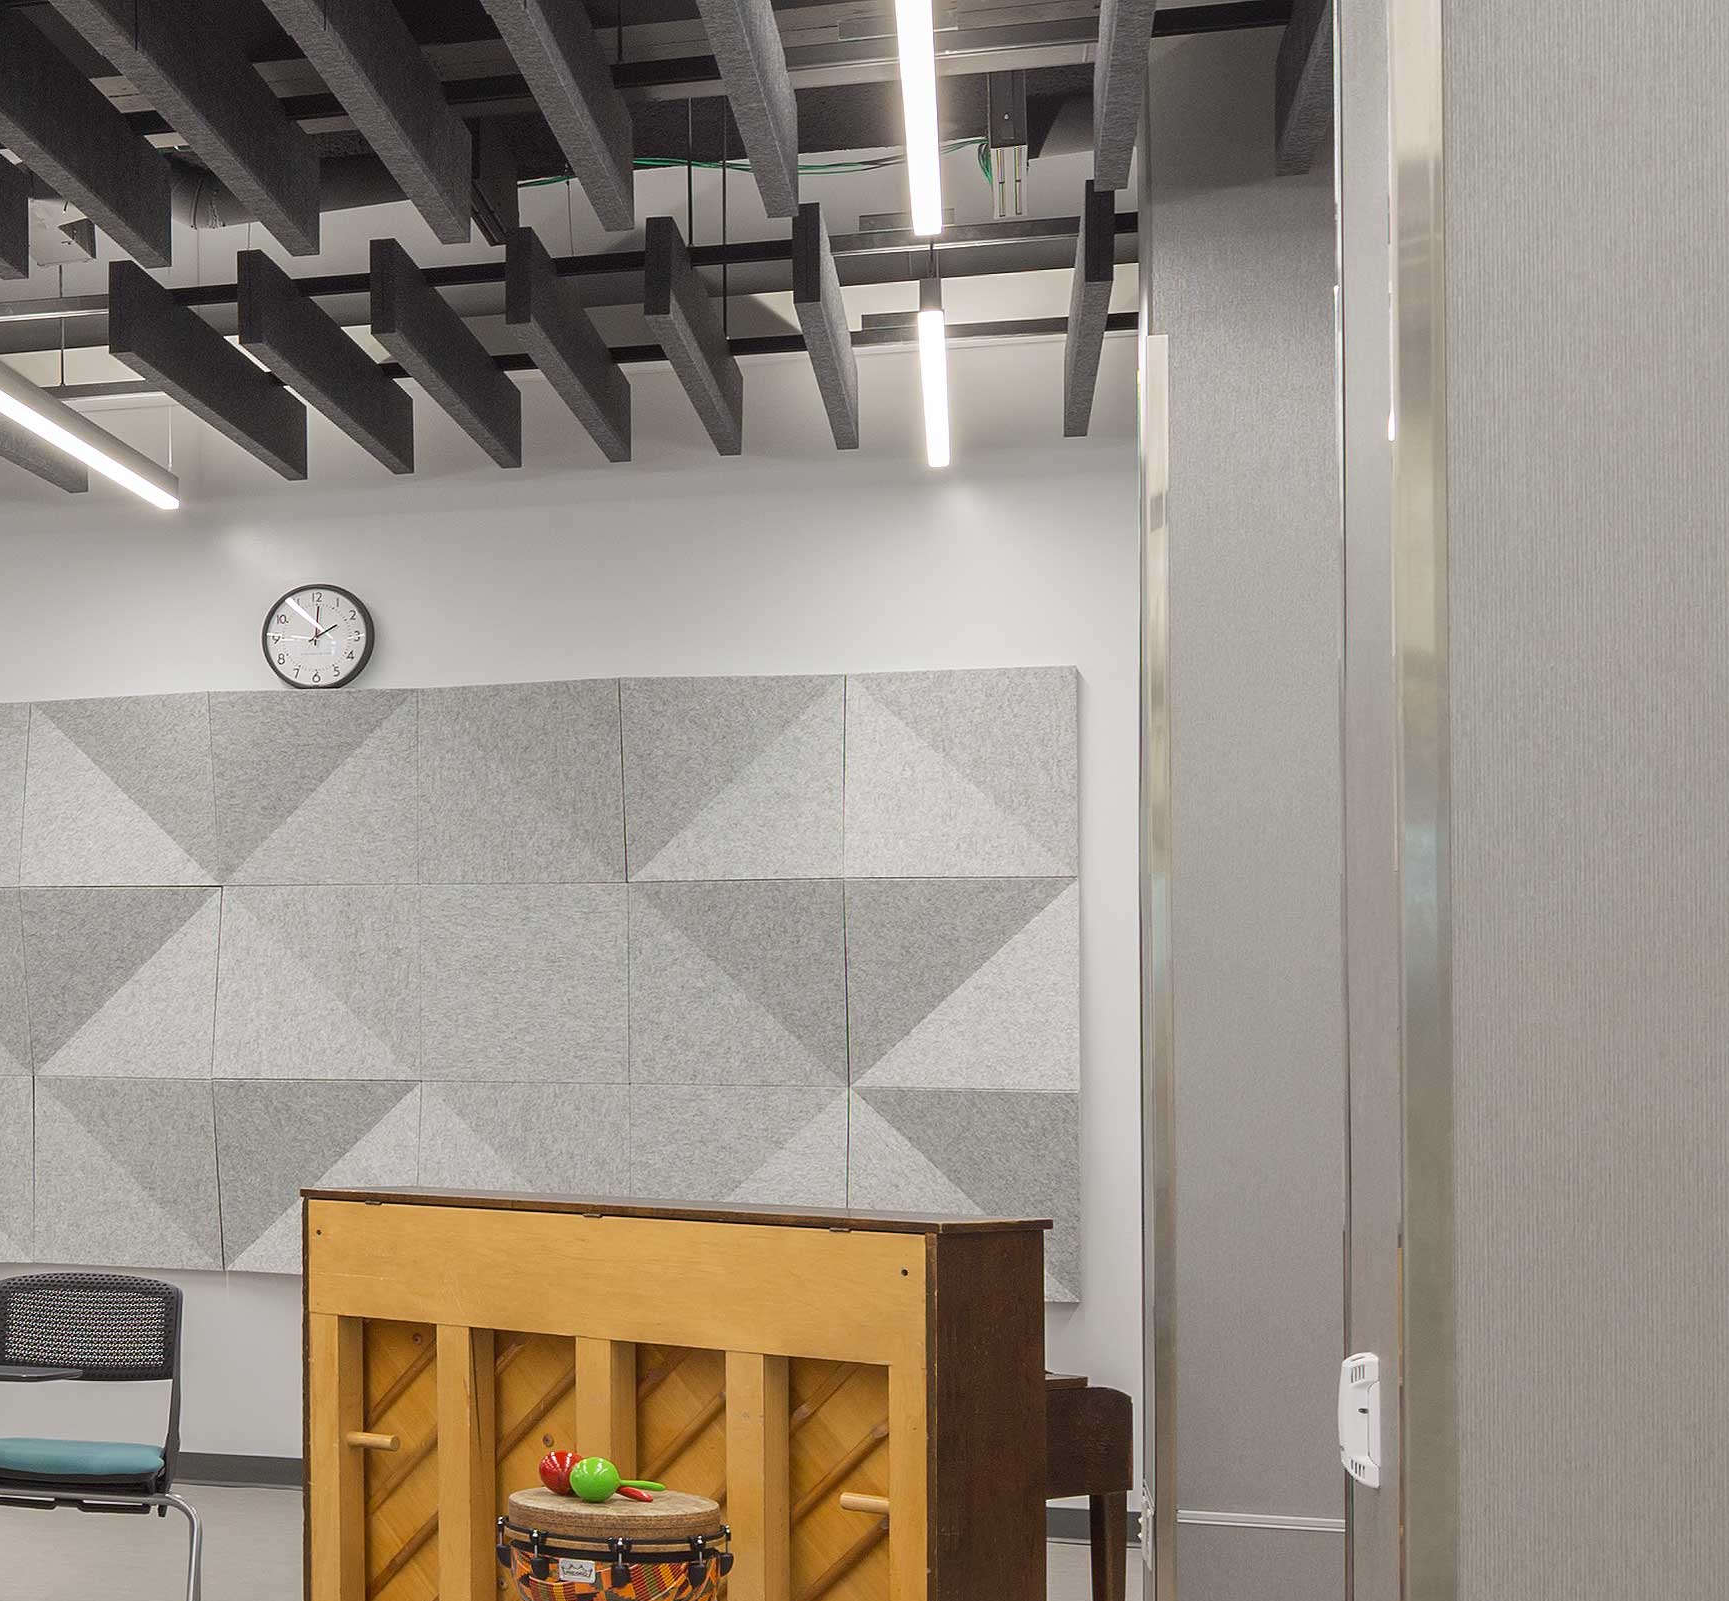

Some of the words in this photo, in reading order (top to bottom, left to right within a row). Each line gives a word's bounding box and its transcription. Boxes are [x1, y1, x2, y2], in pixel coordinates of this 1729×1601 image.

[311, 592, 322, 603] 12
[276, 614, 286, 624] 10
[348, 610, 356, 620] 2
[272, 634, 281, 644] 9
[353, 630, 361, 641] 3
[277, 653, 286, 665] 8
[346, 650, 354, 659] 4
[293, 668, 299, 679] 7
[333, 666, 340, 677] 5
[312, 673, 321, 683] 6
